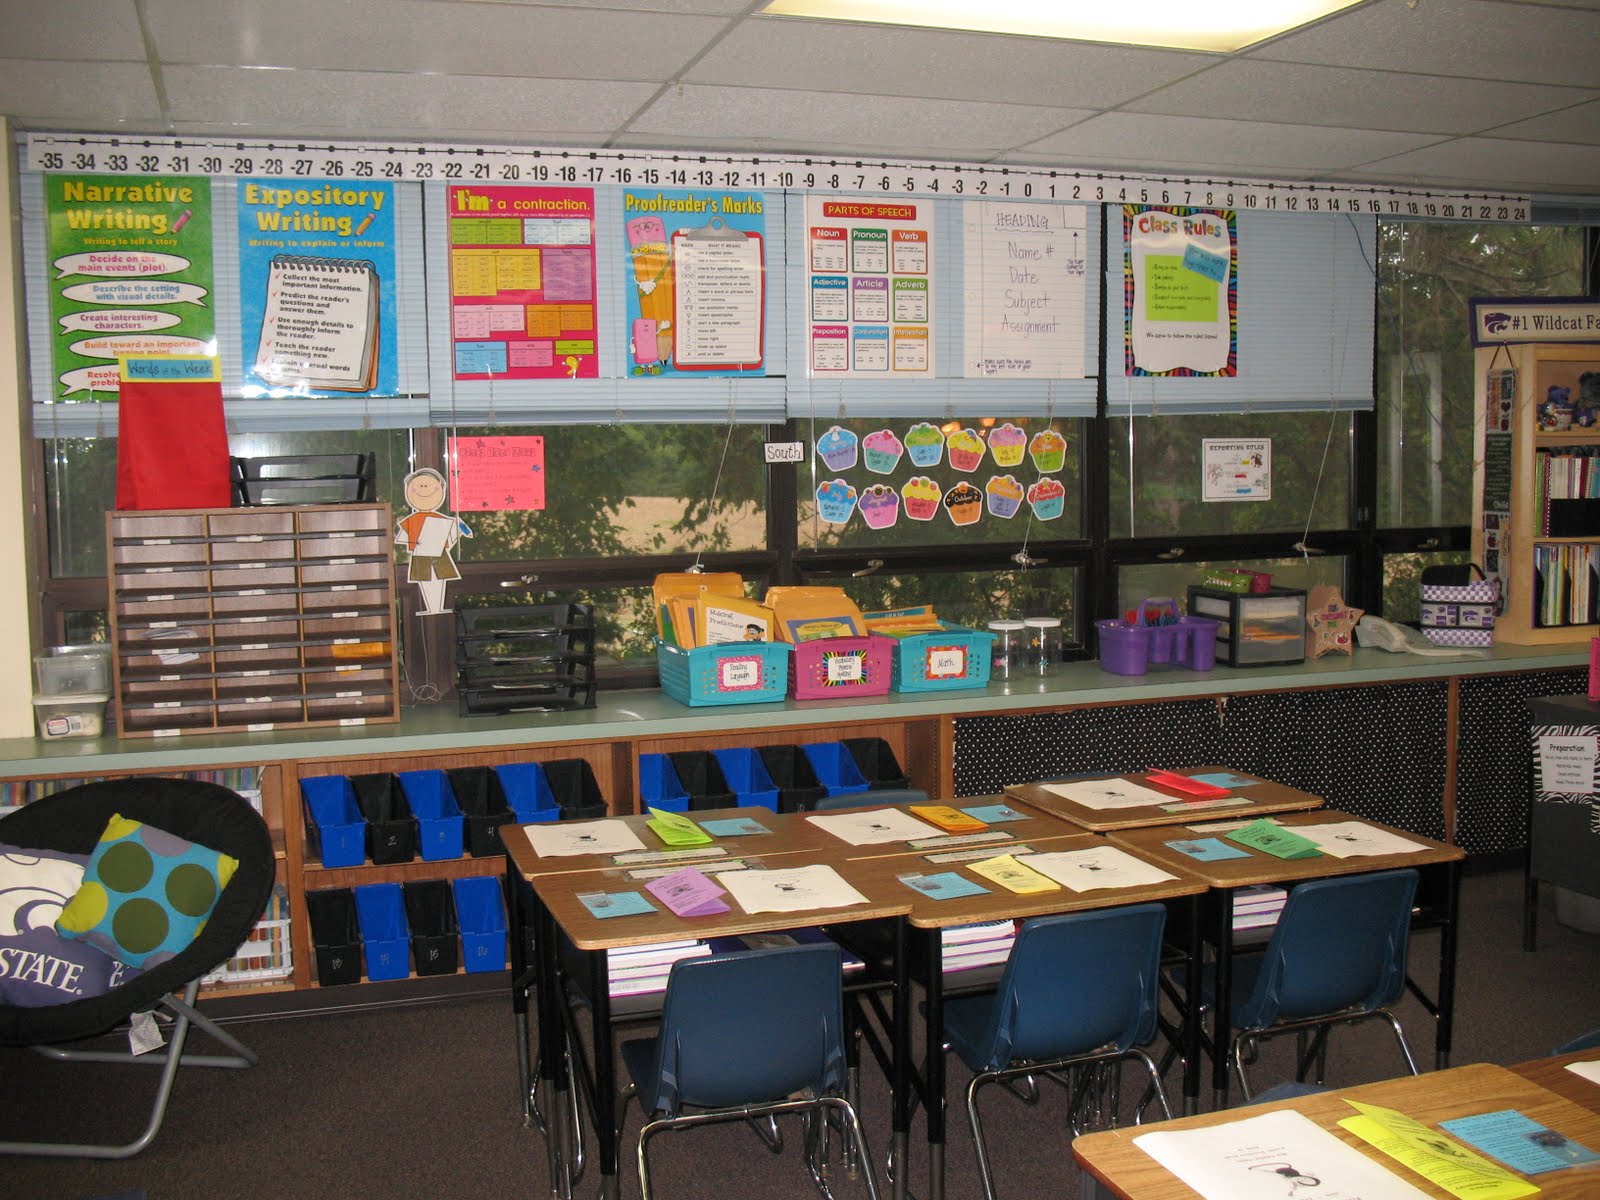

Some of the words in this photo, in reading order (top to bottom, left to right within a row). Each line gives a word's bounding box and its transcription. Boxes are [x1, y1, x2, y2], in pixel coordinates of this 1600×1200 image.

[37, 152, 64, 170] -35
[70, 153, 96, 170] -34
[103, 154, 129, 172] -33
[135, 155, 160, 173] -32
[166, 155, 189, 173] -31
[198, 156, 222, 174] -30
[228, 157, 253, 175] -29
[259, 158, 284, 175] -28
[290, 159, 314, 176] -27
[320, 160, 344, 177] -26
[350, 160, 374, 178] -25
[380, 161, 404, 178] -24
[410, 162, 434, 179] -23
[440, 162, 463, 179] -22
[469, 162, 490, 179] -21
[498, 164, 520, 181] -20
[526, 165, 549, 181] -19
[554, 165, 577, 182] -18
[582, 166, 604, 183] -17
[609, 167, 632, 184] -16
[637, 168, 660, 185] -15
[665, 169, 687, 185] -14
[692, 170, 714, 186] -13
[718, 171, 740, 187] -12
[745, 171, 766, 187] -11
[772, 171, 794, 187] -10
[802, 172, 815, 188] -9
[826, 173, 840, 189] -8
[852, 174, 866, 190] -7
[877, 175, 890, 191] -6
[902, 176, 915, 192] -5
[926, 178, 940, 193] -4
[951, 179, 964, 194] -3
[975, 180, 988, 195] -2
[999, 181, 1010, 196] -1
[1024, 182, 1032, 198] 0
[1048, 184, 1055, 199] 1
[1072, 185, 1081, 200] 2
[1095, 186, 1104, 201] 3
[1118, 187, 1127, 202] 4
[1140, 188, 1148, 203] 5
[1161, 190, 1170, 204] 6
[1184, 191, 1192, 205] 7
[1206, 191, 1214, 206] 8
[1226, 193, 1234, 207] 9
[1243, 194, 1257, 209] 10
[1264, 195, 1277, 210] 11
[1285, 196, 1298, 211] 12
[1305, 197, 1320, 211] 13
[1326, 198, 1340, 212] 14
[1347, 199, 1360, 213] 15
[1367, 199, 1381, 213] 16
[1387, 200, 1400, 213] 17
[1405, 201, 1419, 215] 18
[1423, 203, 1437, 216] 19
[1442, 204, 1455, 218] 20
[1460, 204, 1473, 218] 21
[1479, 205, 1491, 219] 22
[1497, 206, 1509, 220] 23
[1514, 207, 1526, 221] 24
[64, 182, 192, 202] Narrative
[245, 184, 385, 210] Expository
[456, 189, 490, 211] I'm
[497, 200, 507, 210] a
[514, 198, 590, 210] contraction.
[625, 193, 718, 214] Proofreader's
[722, 196, 764, 214] Marks
[828, 206, 860, 216] PARTS
[862, 207, 875, 216] OF
[878, 208, 912, 218] SPEECH
[67, 208, 168, 235] Writing
[256, 210, 352, 237] Writing
[996, 212, 1049, 229] HEADING
[1138, 216, 1178, 234] Class
[1183, 219, 1222, 238] Rules
[816, 228, 840, 238] Noun
[853, 230, 887, 240] Pronoun
[899, 232, 919, 240] Verb
[84, 238, 116, 246] Writing
[156, 238, 177, 246] story
[248, 240, 284, 248] Writing
[301, 240, 337, 248] explain
[1008, 242, 1042, 261] Name
[1045, 246, 1055, 258] #
[78, 264, 102, 272] main
[105, 264, 136, 272] events
[139, 264, 168, 273] (plot).
[282, 274, 308, 282] Collect
[1010, 266, 1040, 285] Date
[282, 281, 318, 290] important
[320, 283, 363, 292] information.
[813, 278, 847, 288] Adjective
[856, 279, 884, 288] Article
[895, 280, 926, 289] Adverb
[151, 286, 180, 294] setting
[280, 292, 306, 300] Predict
[320, 294, 350, 304] reader's
[1005, 290, 1051, 316] Subject
[280, 300, 314, 308] questions
[80, 314, 109, 322] Create
[111, 314, 158, 323] interesting
[292, 318, 320, 326] enough
[320, 320, 345, 328] details
[1512, 315, 1528, 330] #1
[1532, 314, 1584, 330] Wildcat
[94, 322, 144, 330] characters.
[277, 324, 316, 334] thoroughly
[317, 326, 341, 335] inform
[1001, 314, 1060, 338] Assignment
[812, 328, 847, 336] Preposition
[156, 341, 200, 350] important
[128, 360, 160, 377] Words
[184, 360, 214, 374] Week
[767, 444, 801, 460] South
[938, 657, 955, 668] Math
[1550, 744, 1585, 752] Preparation
[488, 826, 494, 837] 4
[388, 835, 397, 846] 2
